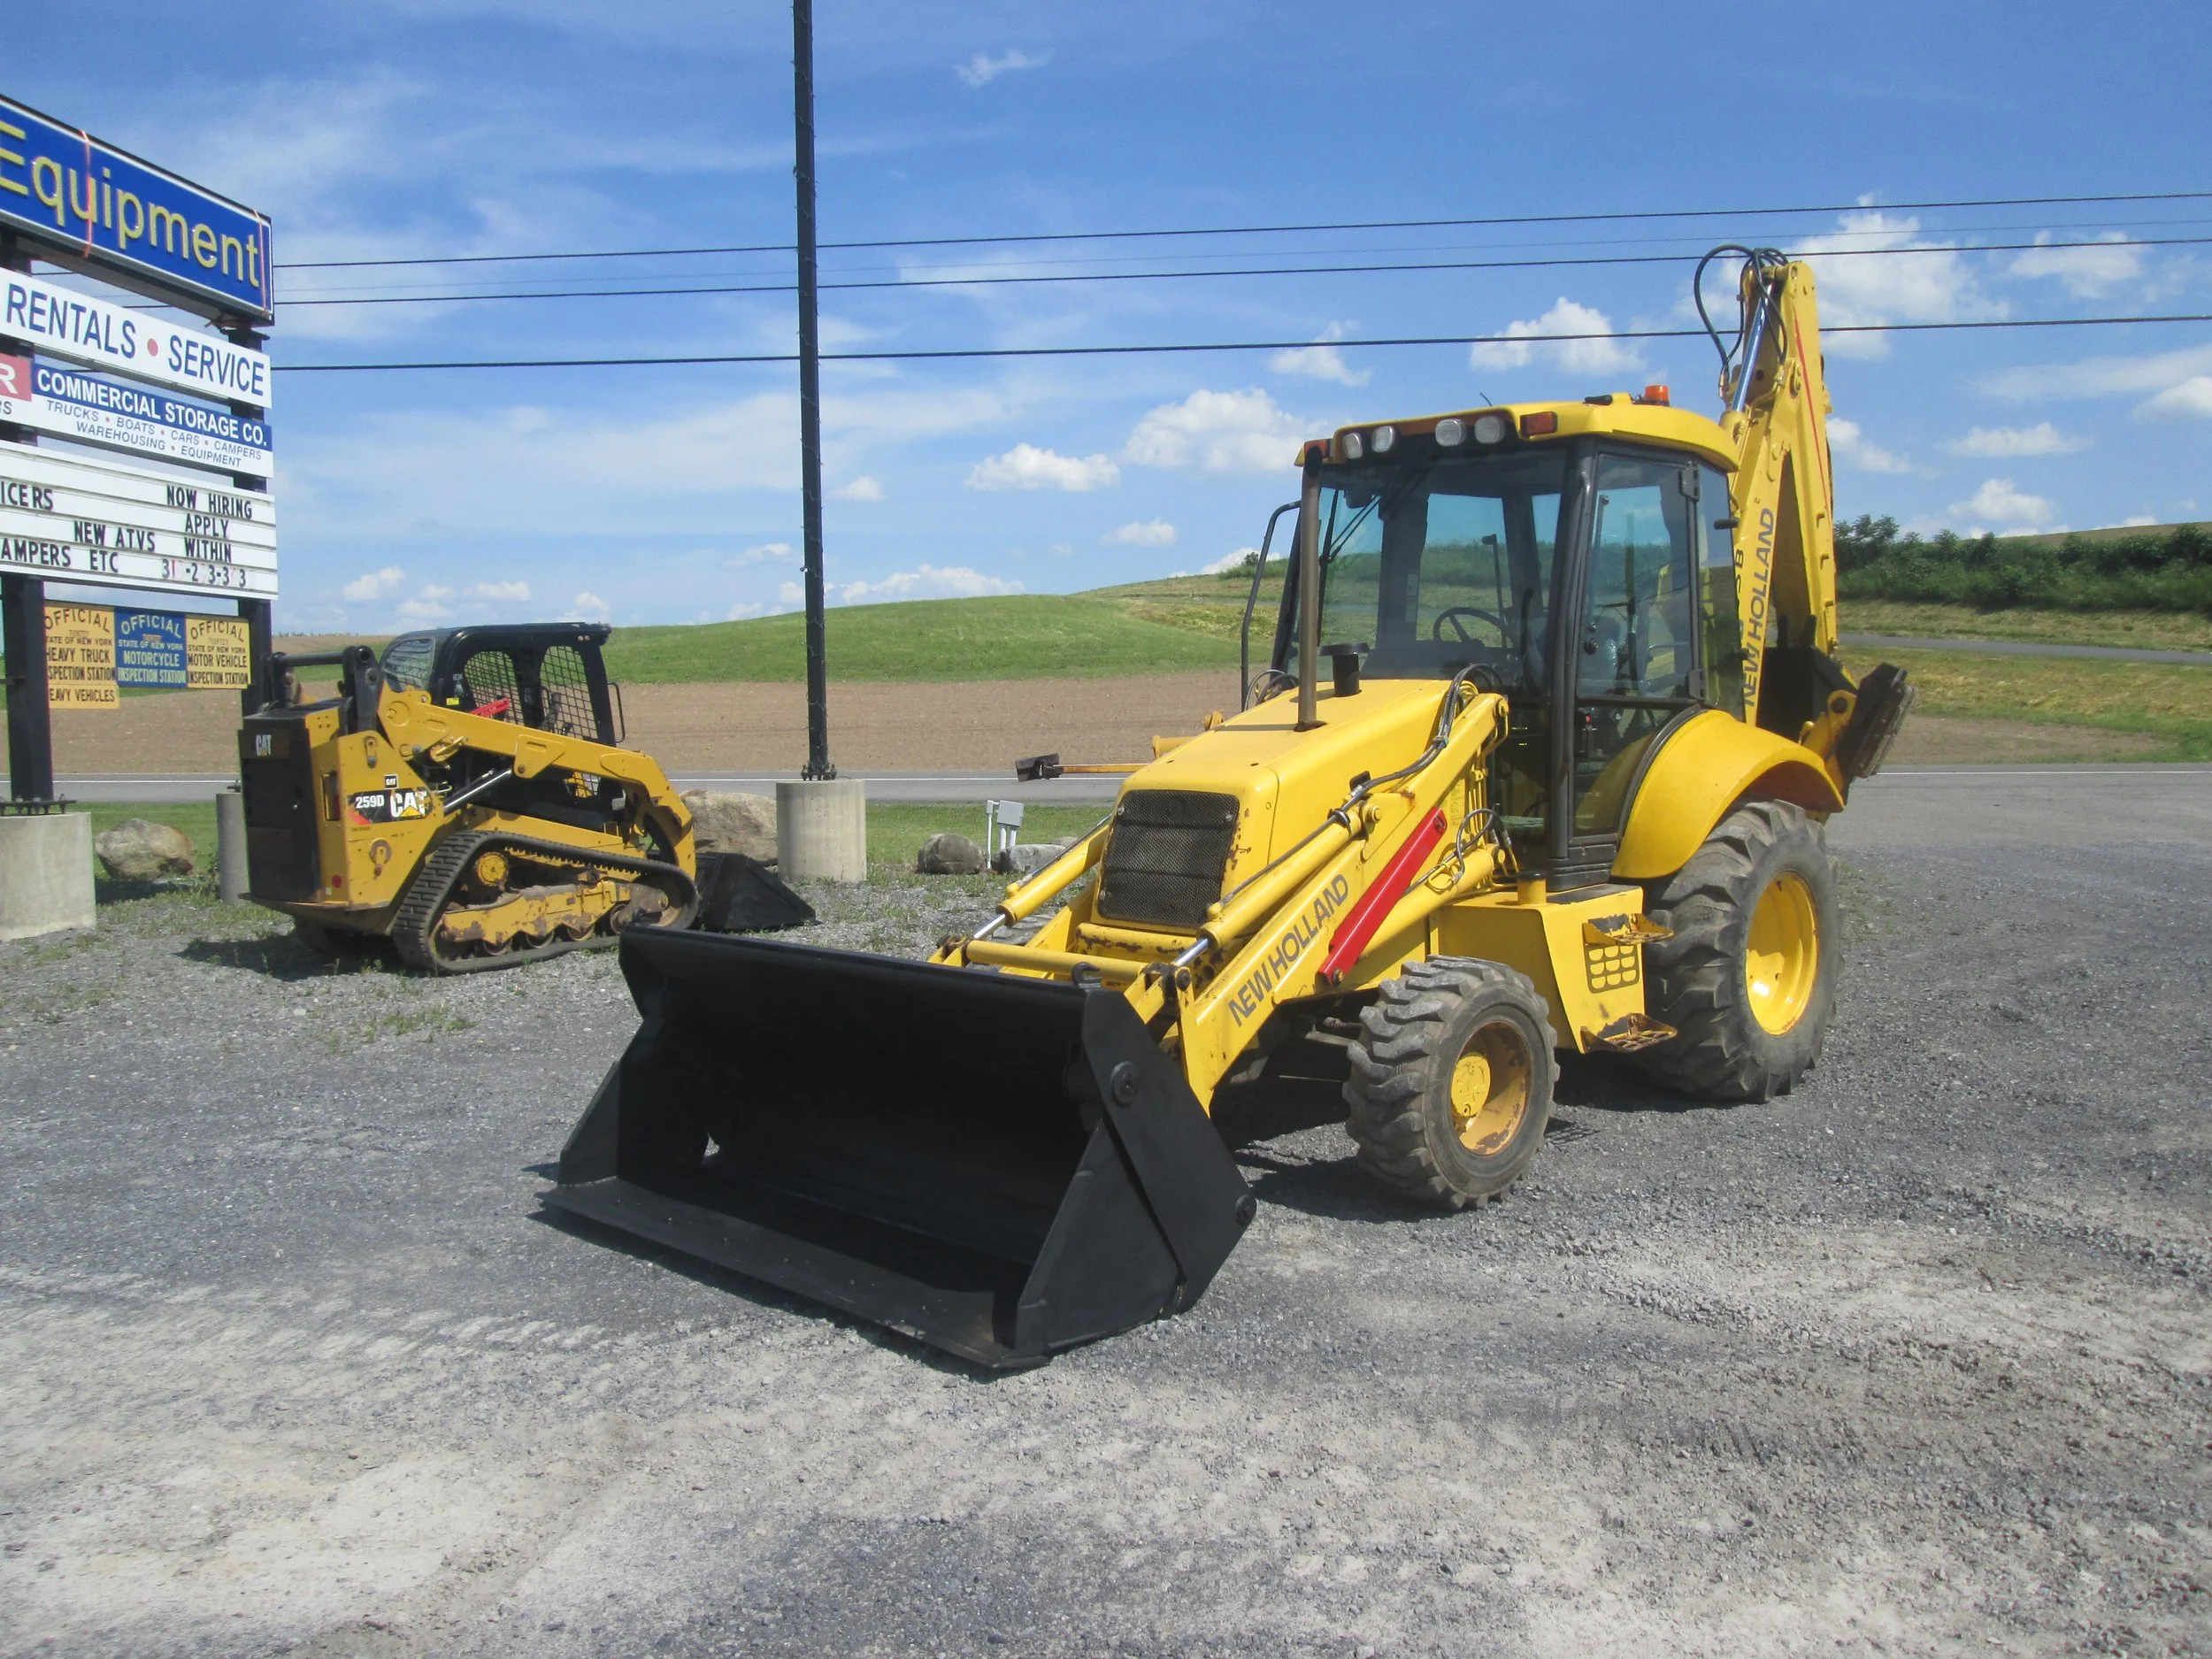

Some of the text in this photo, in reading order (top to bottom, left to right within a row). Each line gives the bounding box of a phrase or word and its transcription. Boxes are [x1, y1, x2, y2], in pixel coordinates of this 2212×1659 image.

[0, 120, 259, 288] Equipment
[7, 283, 265, 396] RENTALS SERVICE
[37, 368, 267, 446] COMMERCIAL STORAGE CO.
[47, 400, 262, 460] TRUCKS BOATS CARS CAMPERS
[77, 421, 242, 467] WAREHOUSING EQUIPMENT
[166, 485, 252, 519] NOW HIRING
[74, 520, 155, 552] NEW ATVS
[185, 512, 228, 539] APPLY
[1, 537, 119, 573] AMPERS ETC
[184, 536, 231, 563] WITHIN
[45, 609, 110, 633] OFFICIAL
[1743, 508, 1774, 707] NEW HOLLAND
[121, 614, 181, 639] OFFICIAL
[190, 620, 244, 642] OFFICIAL
[81, 649, 111, 663] TRUCK
[118, 639, 139, 648] STATE
[124, 650, 180, 667] MOTORCYCLE
[188, 653, 247, 668] MOTOR VEHICLE
[48, 665, 115, 680] SPECTION STATION
[118, 667, 186, 683] INSPECTION STATION
[188, 672, 248, 685] INSPECTION STATION
[50, 688, 115, 703] EAVY VEHICLES
[257, 734, 271, 757] CAT
[356, 790, 427, 818] 259D CAT
[1227, 874, 1348, 1027] NEW HOLLAND
